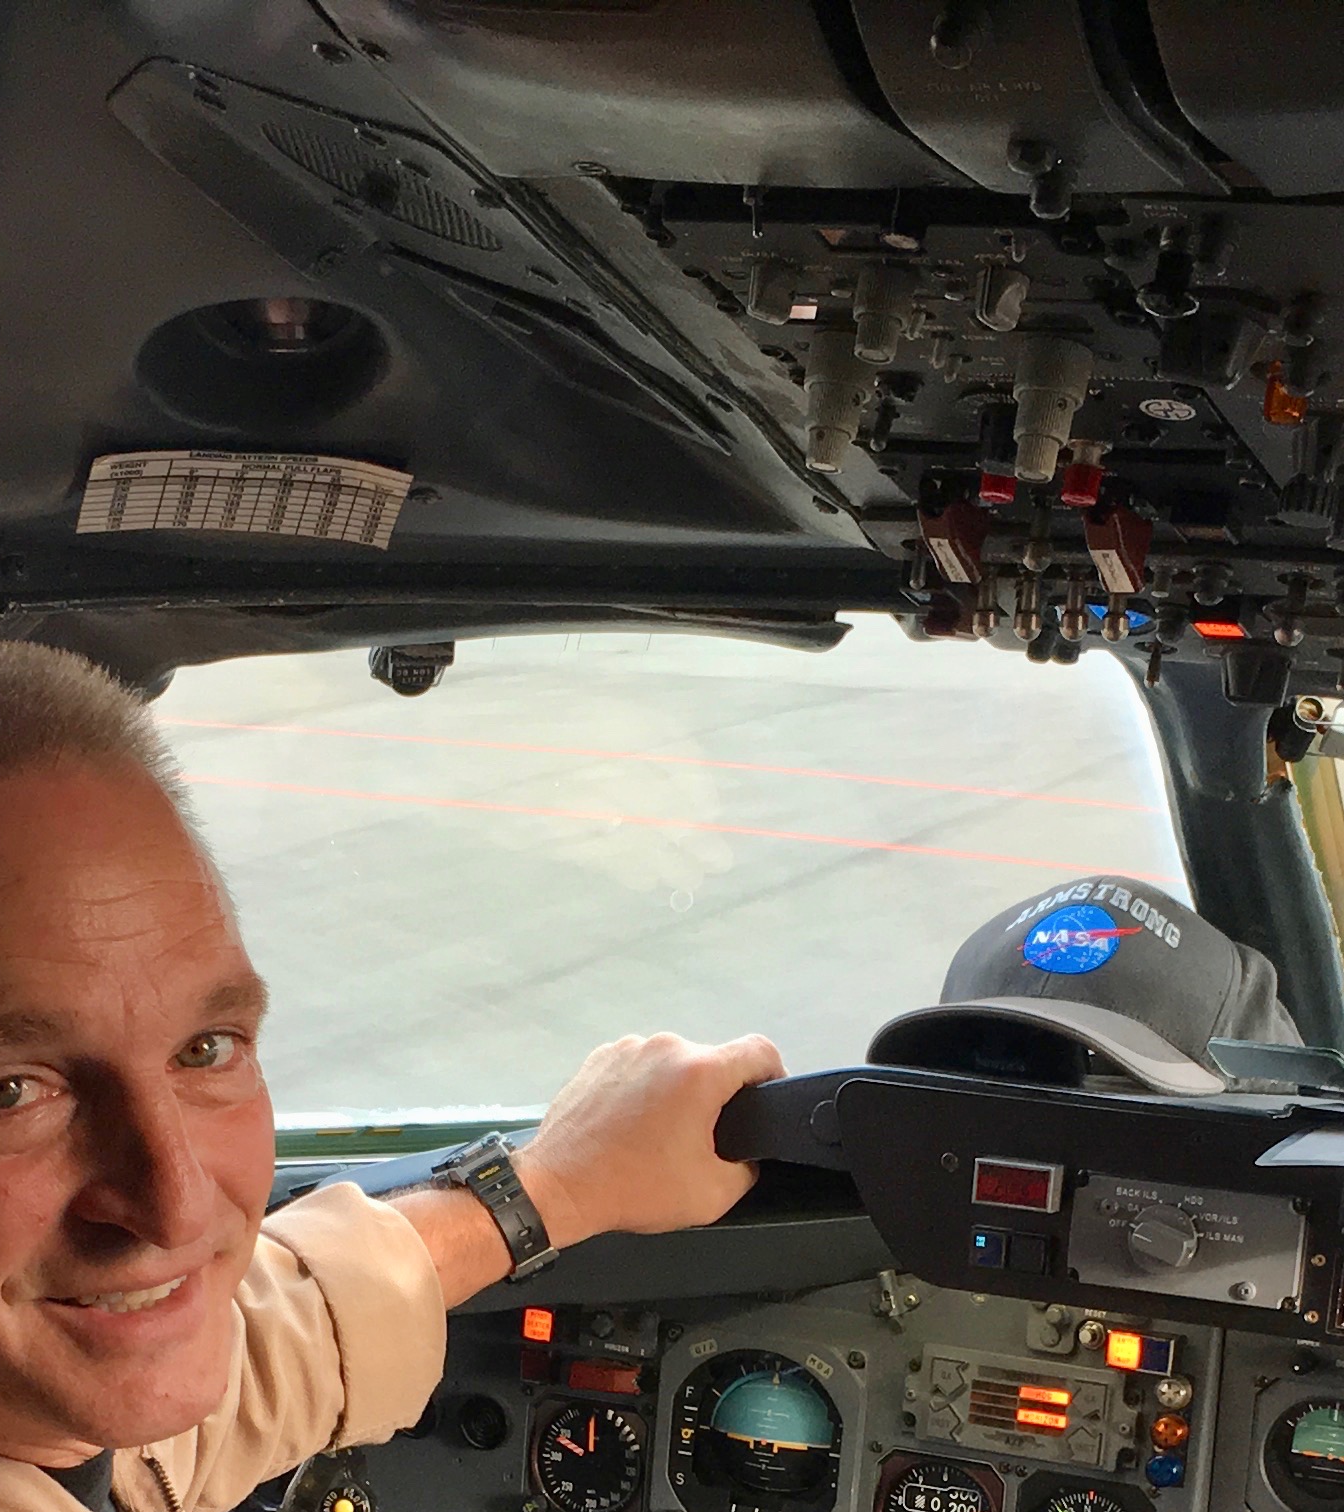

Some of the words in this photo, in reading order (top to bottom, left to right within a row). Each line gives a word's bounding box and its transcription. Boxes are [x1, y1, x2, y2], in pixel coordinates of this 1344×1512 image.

[110, 462, 148, 470] WEIGHT
[242, 463, 282, 471] NORMAL
[1006, 882, 1181, 948] ARMSTRONG
[1031, 929, 1110, 952] NASA
